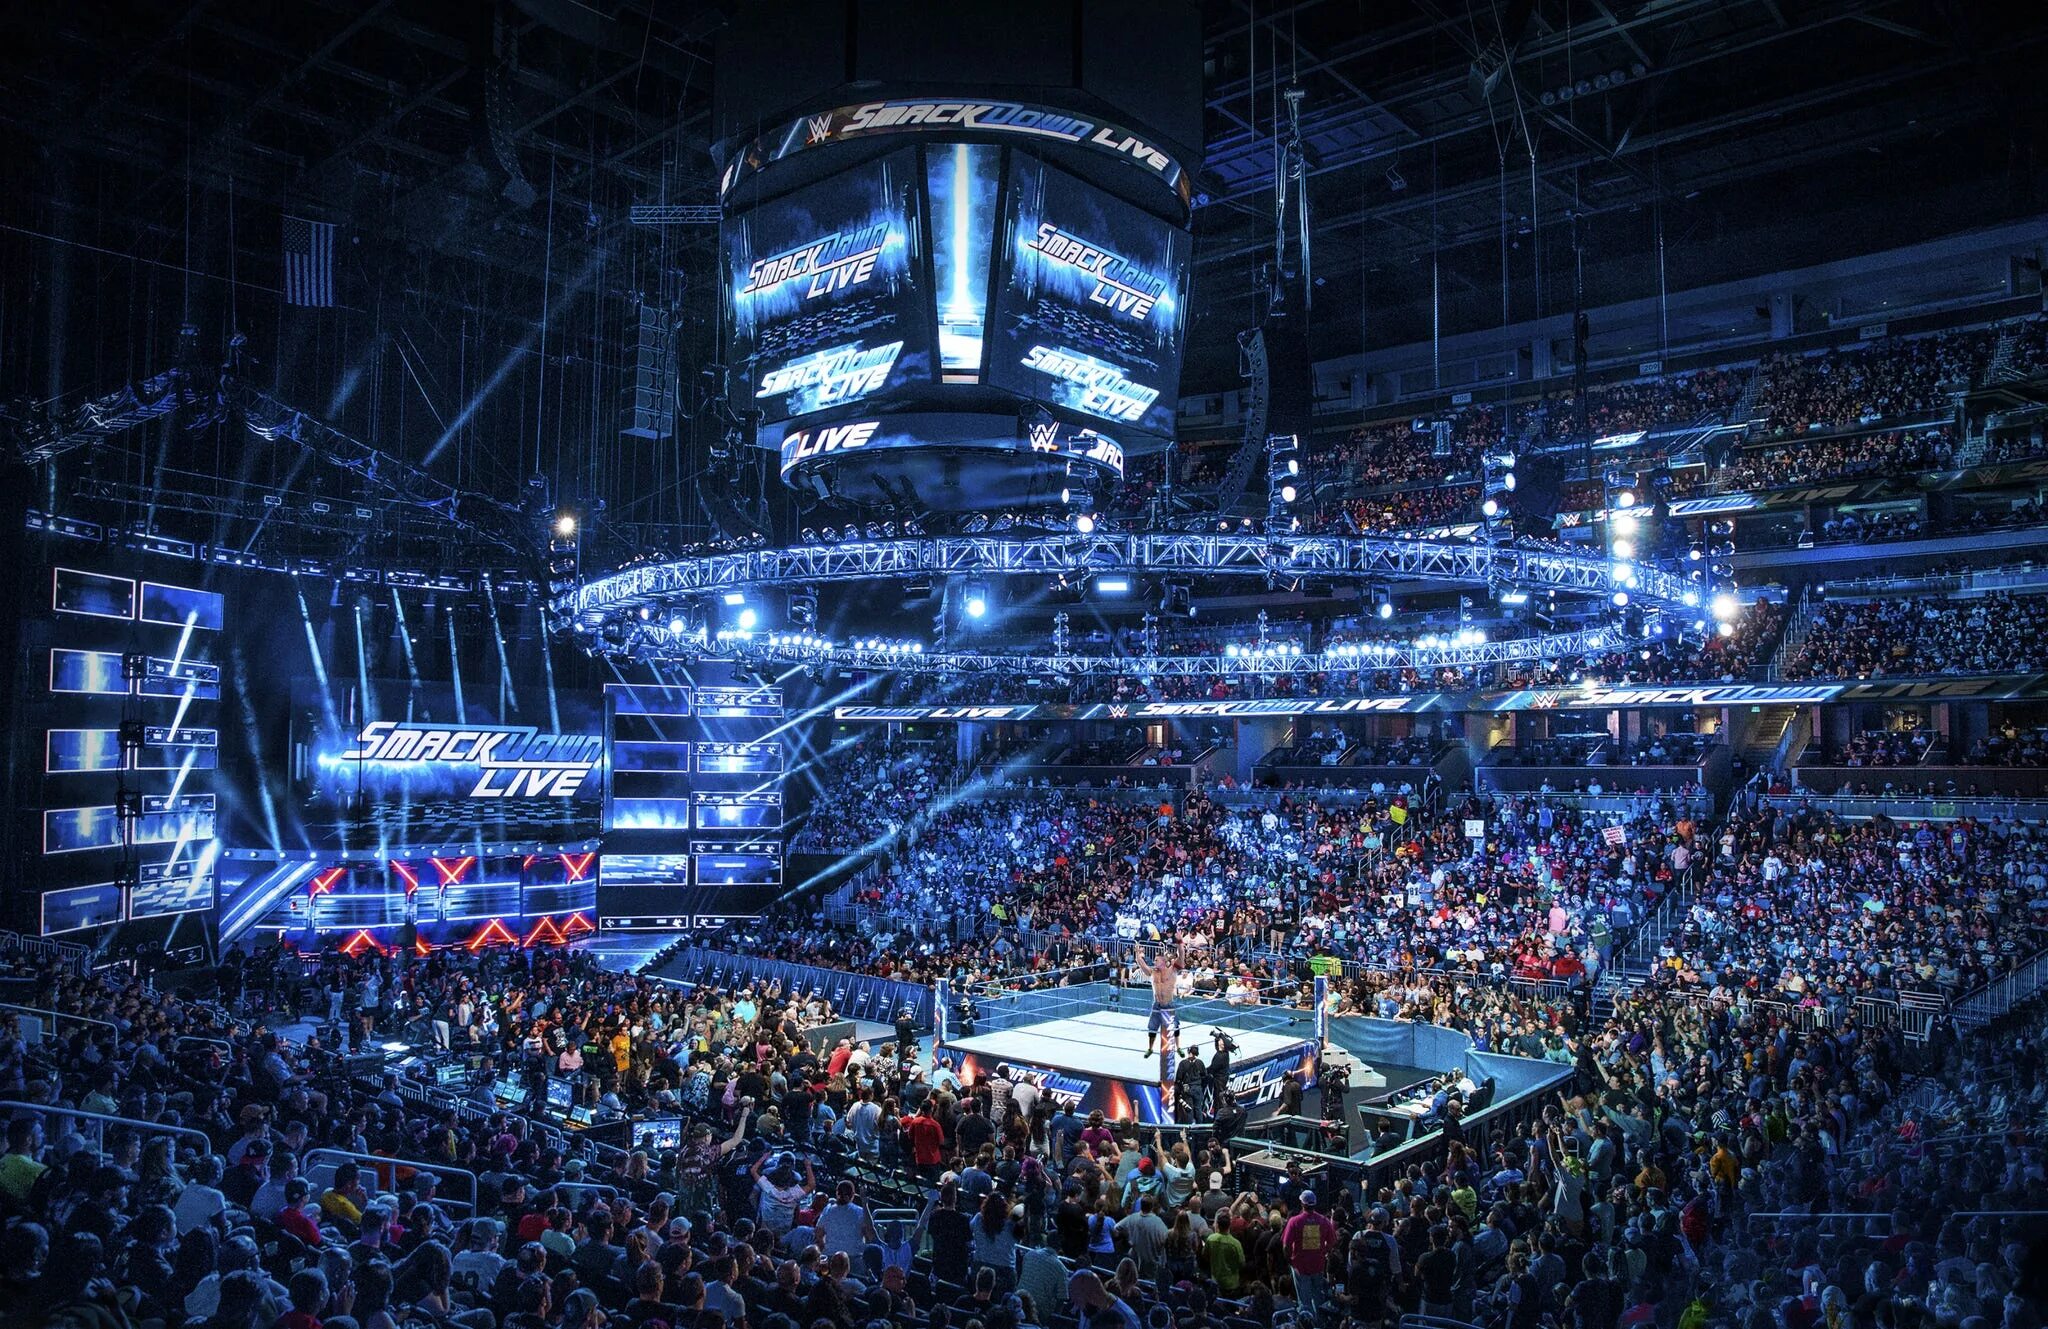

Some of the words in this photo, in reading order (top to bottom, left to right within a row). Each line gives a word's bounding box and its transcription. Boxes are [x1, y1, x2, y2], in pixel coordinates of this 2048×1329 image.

[1091, 127, 1168, 171] LIVE
[805, 254, 877, 299] LIVE
[1090, 281, 1156, 320] LIVE
[814, 365, 895, 401] LIVE
[1084, 388, 1151, 421] LIVE
[796, 421, 879, 457] LIVE
[1764, 485, 1860, 504] LIVE
[1313, 698, 1410, 711] LIVE
[1840, 680, 1997, 698] LIVE
[927, 708, 1013, 718] LIVE
[469, 769, 588, 797] LIVE
